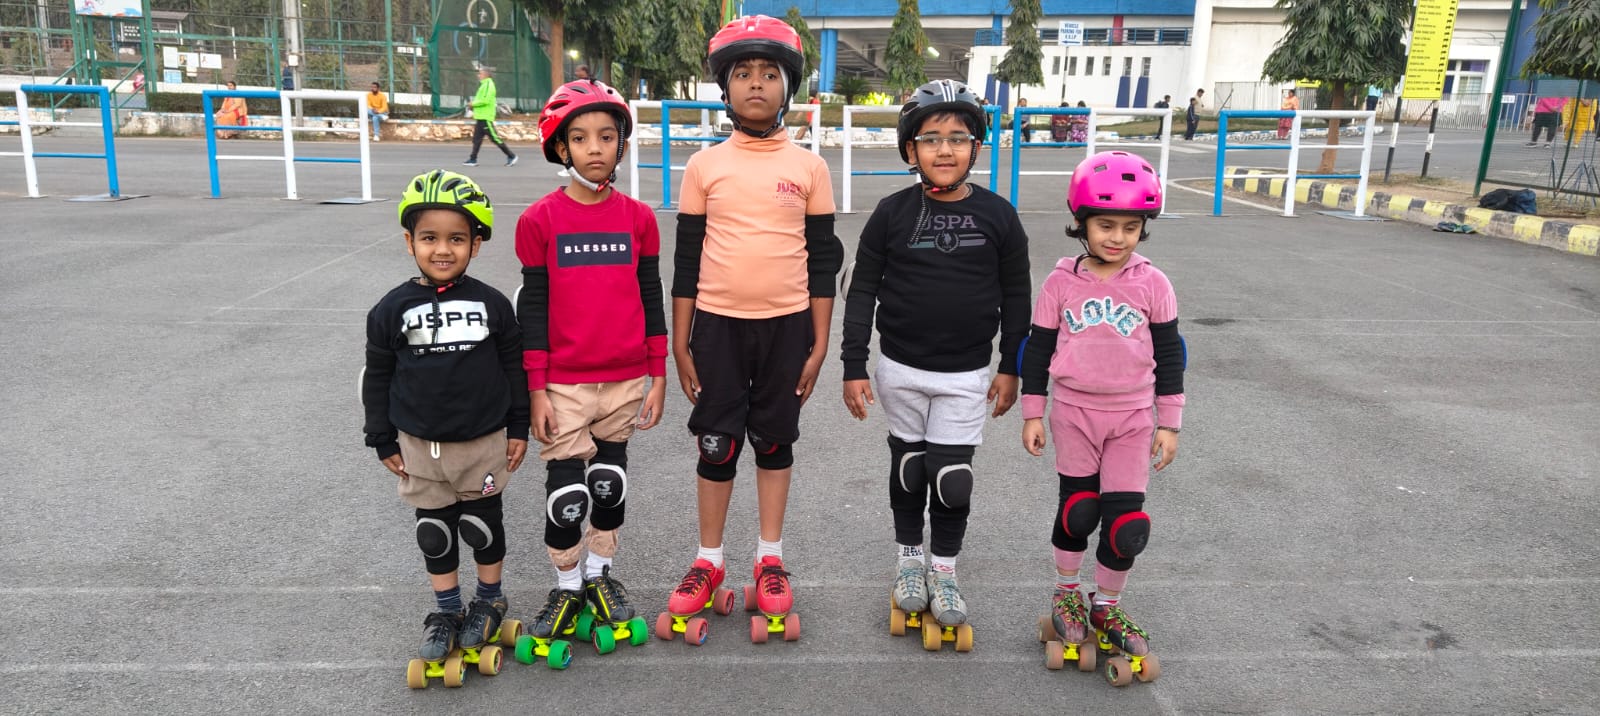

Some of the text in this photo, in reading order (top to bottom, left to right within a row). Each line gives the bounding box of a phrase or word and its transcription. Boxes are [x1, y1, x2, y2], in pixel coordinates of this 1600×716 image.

[564, 243, 627, 254] BLESSED
[406, 311, 484, 330] USPA
[1064, 296, 1144, 337] LOVE
[429, 345, 456, 353] POLO
